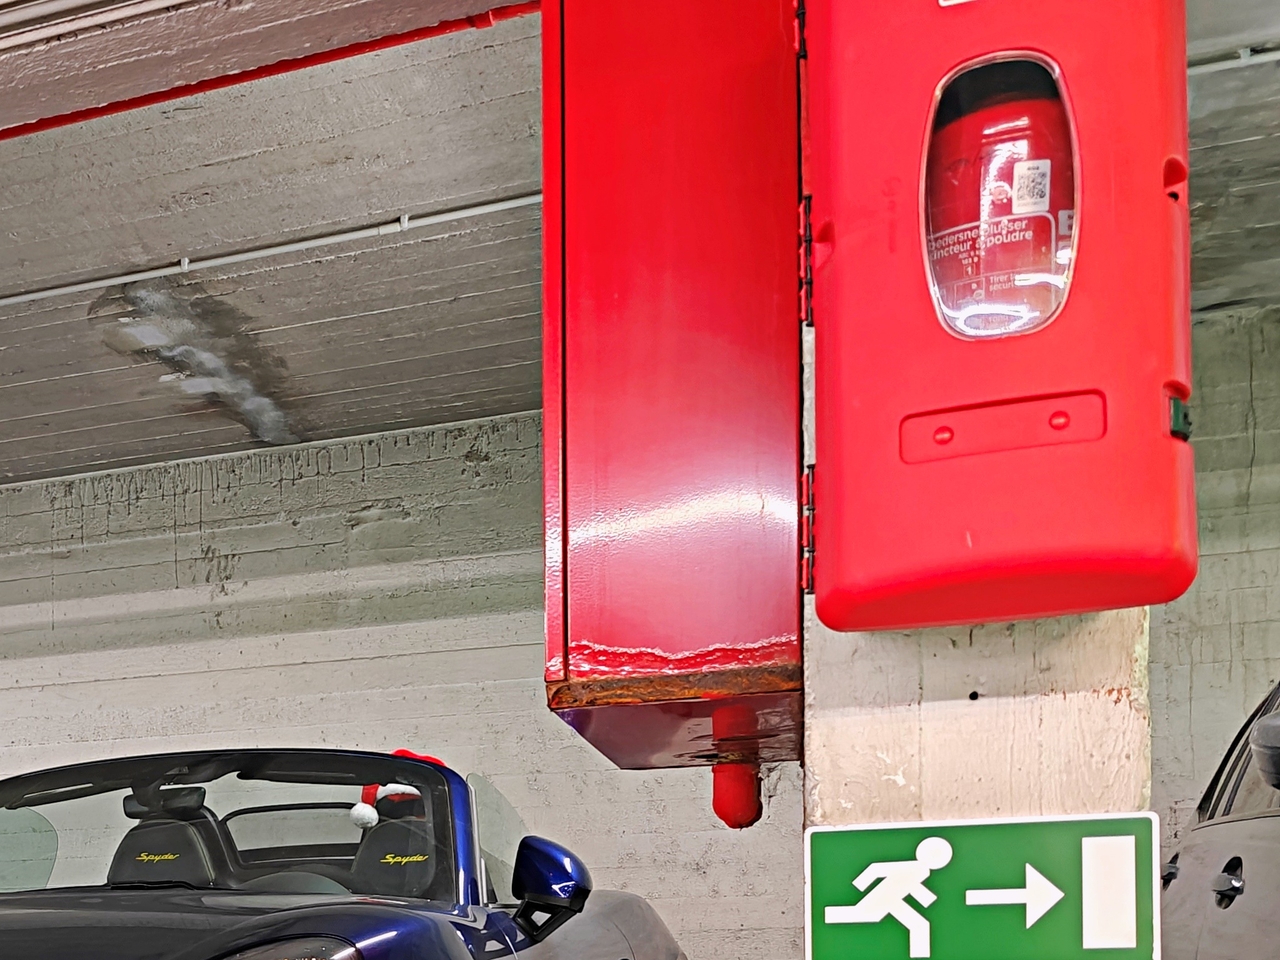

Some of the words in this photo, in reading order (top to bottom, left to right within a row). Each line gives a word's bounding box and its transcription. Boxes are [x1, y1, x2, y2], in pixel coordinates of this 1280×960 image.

[986, 230, 1033, 247] poudre
[135, 852, 180, 864] Spyder
[380, 853, 429, 866] Spyder
